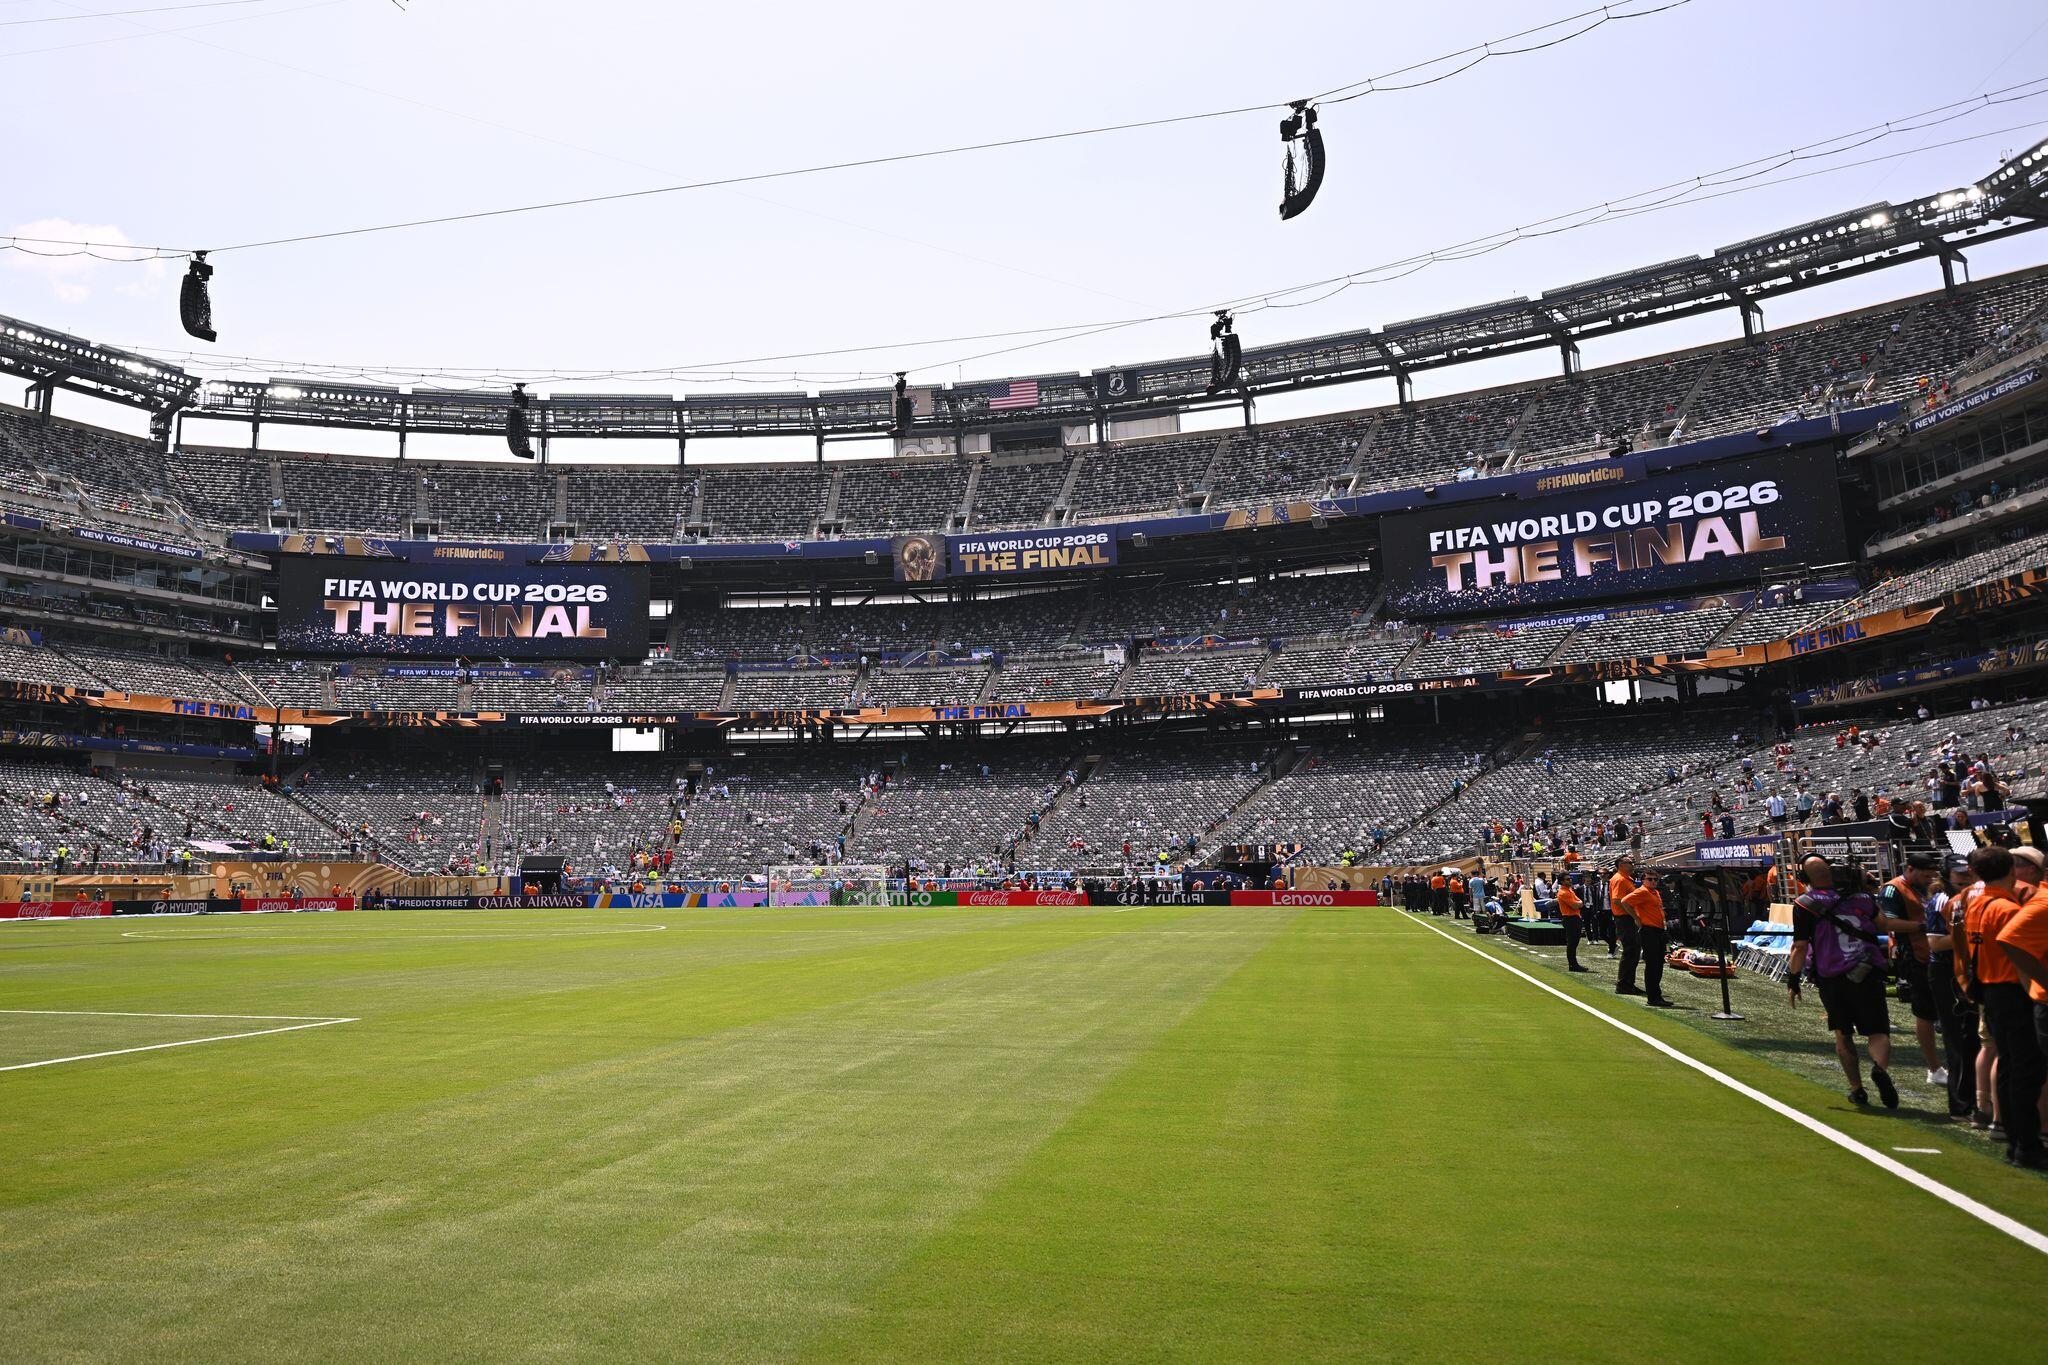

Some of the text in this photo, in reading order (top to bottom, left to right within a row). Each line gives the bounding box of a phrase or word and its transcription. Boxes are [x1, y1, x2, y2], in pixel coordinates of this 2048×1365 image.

[1915, 372, 2034, 429] NEW YORK NEW JERSEY
[1537, 467, 1624, 491] #FIFAWorldCup
[1430, 480, 1779, 552] FIFA WORLD CUP 2026
[80, 529, 197, 557] NEW YORK NEW JERSEY
[959, 533, 1109, 553] FIFA WORLD CUP 2026
[433, 546, 505, 561] #FIFAWorldCup
[959, 545, 1110, 573] THE FINAL
[1432, 510, 1786, 593] THE FINAL
[324, 578, 607, 602] FIFA WORLD CUP 2026
[324, 600, 607, 638] THE FINAL
[1528, 619, 1557, 629] WORLD
[1557, 617, 1575, 625] CUP
[1575, 614, 1605, 623] 2026
[1608, 610, 1630, 620] THE
[1630, 607, 1661, 617] FINAL
[1787, 621, 1867, 655] THE FINAL
[1299, 678, 1480, 699] FIFA WORLD CUP 2026 THE FINAL
[172, 699, 257, 721] THE FINAL
[932, 704, 1031, 720] THE FINAL
[520, 716, 679, 724] FIFA WORLD CUP 2026 THE FINAL
[1733, 845, 1749, 858] 2026
[1749, 844, 1762, 857] THE
[267, 872, 283, 881] FIFA
[257, 899, 289, 911] Lenovo
[303, 899, 337, 910] Lenovo
[399, 899, 469, 907] PREDICTSTREET
[478, 895, 583, 910] QATAR AIRWAYS
[629, 895, 664, 908] VISA
[969, 891, 1010, 906] Coca-Cola
[1036, 891, 1077, 906] Coca-Cola
[1272, 891, 1333, 906] Lenovo
[18, 902, 53, 918] Coca-Cola
[71, 901, 103, 917] Coca-Cola
[170, 902, 207, 913] HYUNDAI
